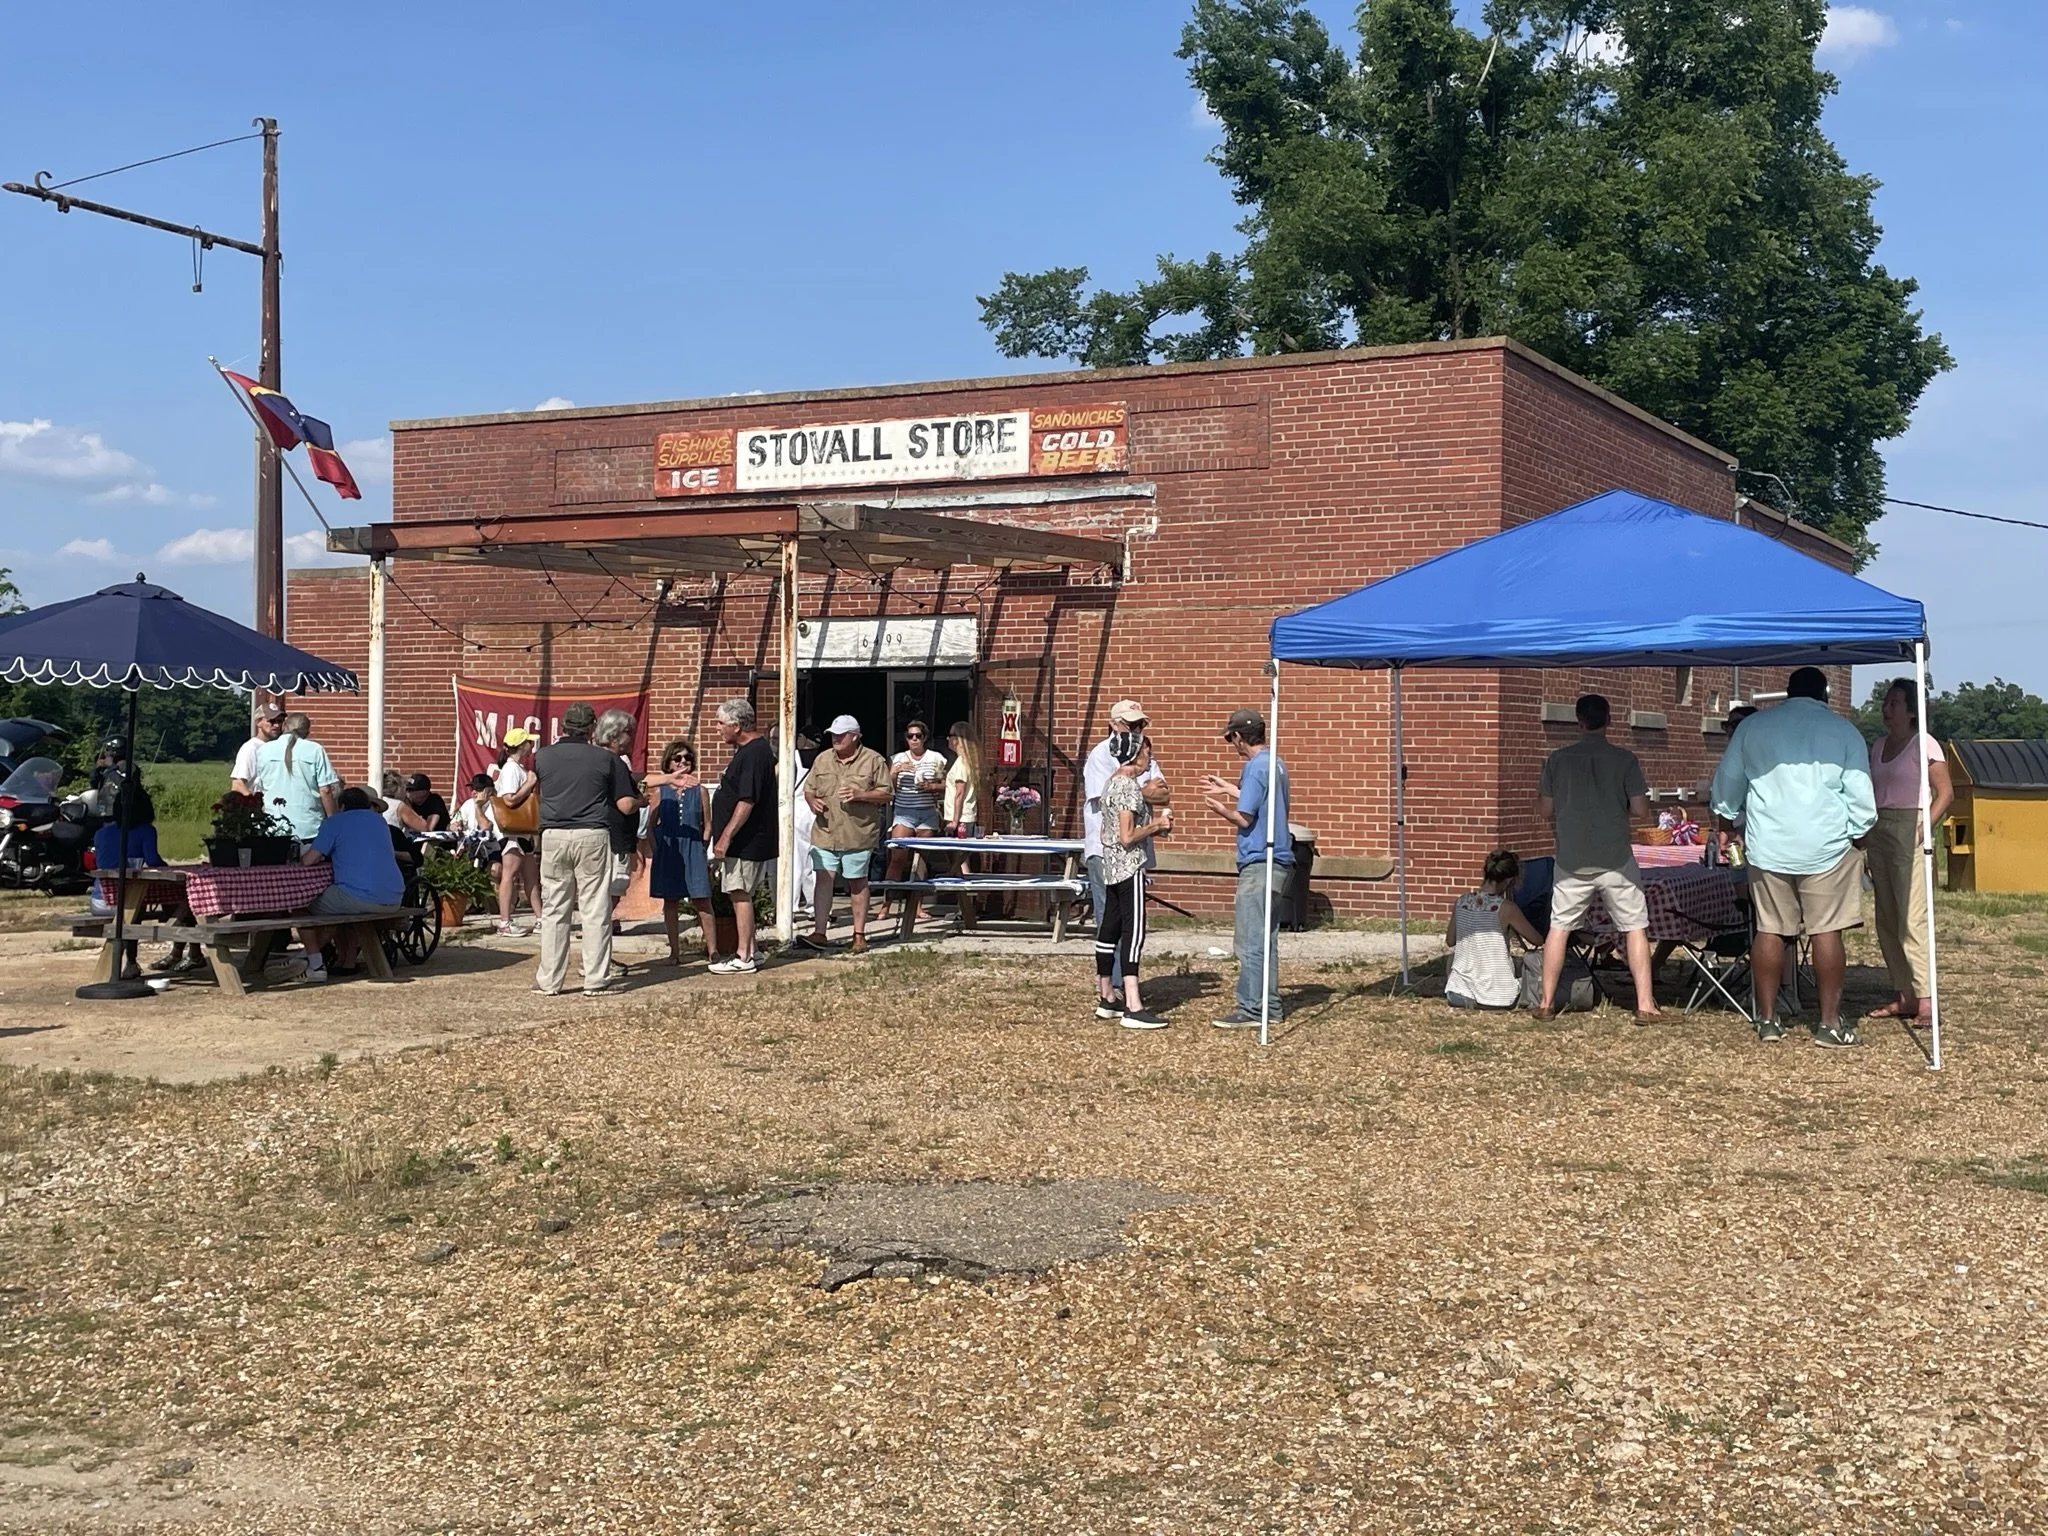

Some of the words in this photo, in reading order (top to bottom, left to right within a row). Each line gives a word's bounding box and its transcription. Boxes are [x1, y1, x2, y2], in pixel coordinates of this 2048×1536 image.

[1031, 408, 1126, 429] SANDWICHES
[659, 435, 732, 453] FISHING
[748, 426, 893, 468] STOVALL
[908, 416, 1018, 459] STORE
[1041, 429, 1116, 452] COLD
[658, 449, 734, 467] SUPPLIES
[1040, 448, 1117, 467] BEER
[671, 467, 720, 489] ICE
